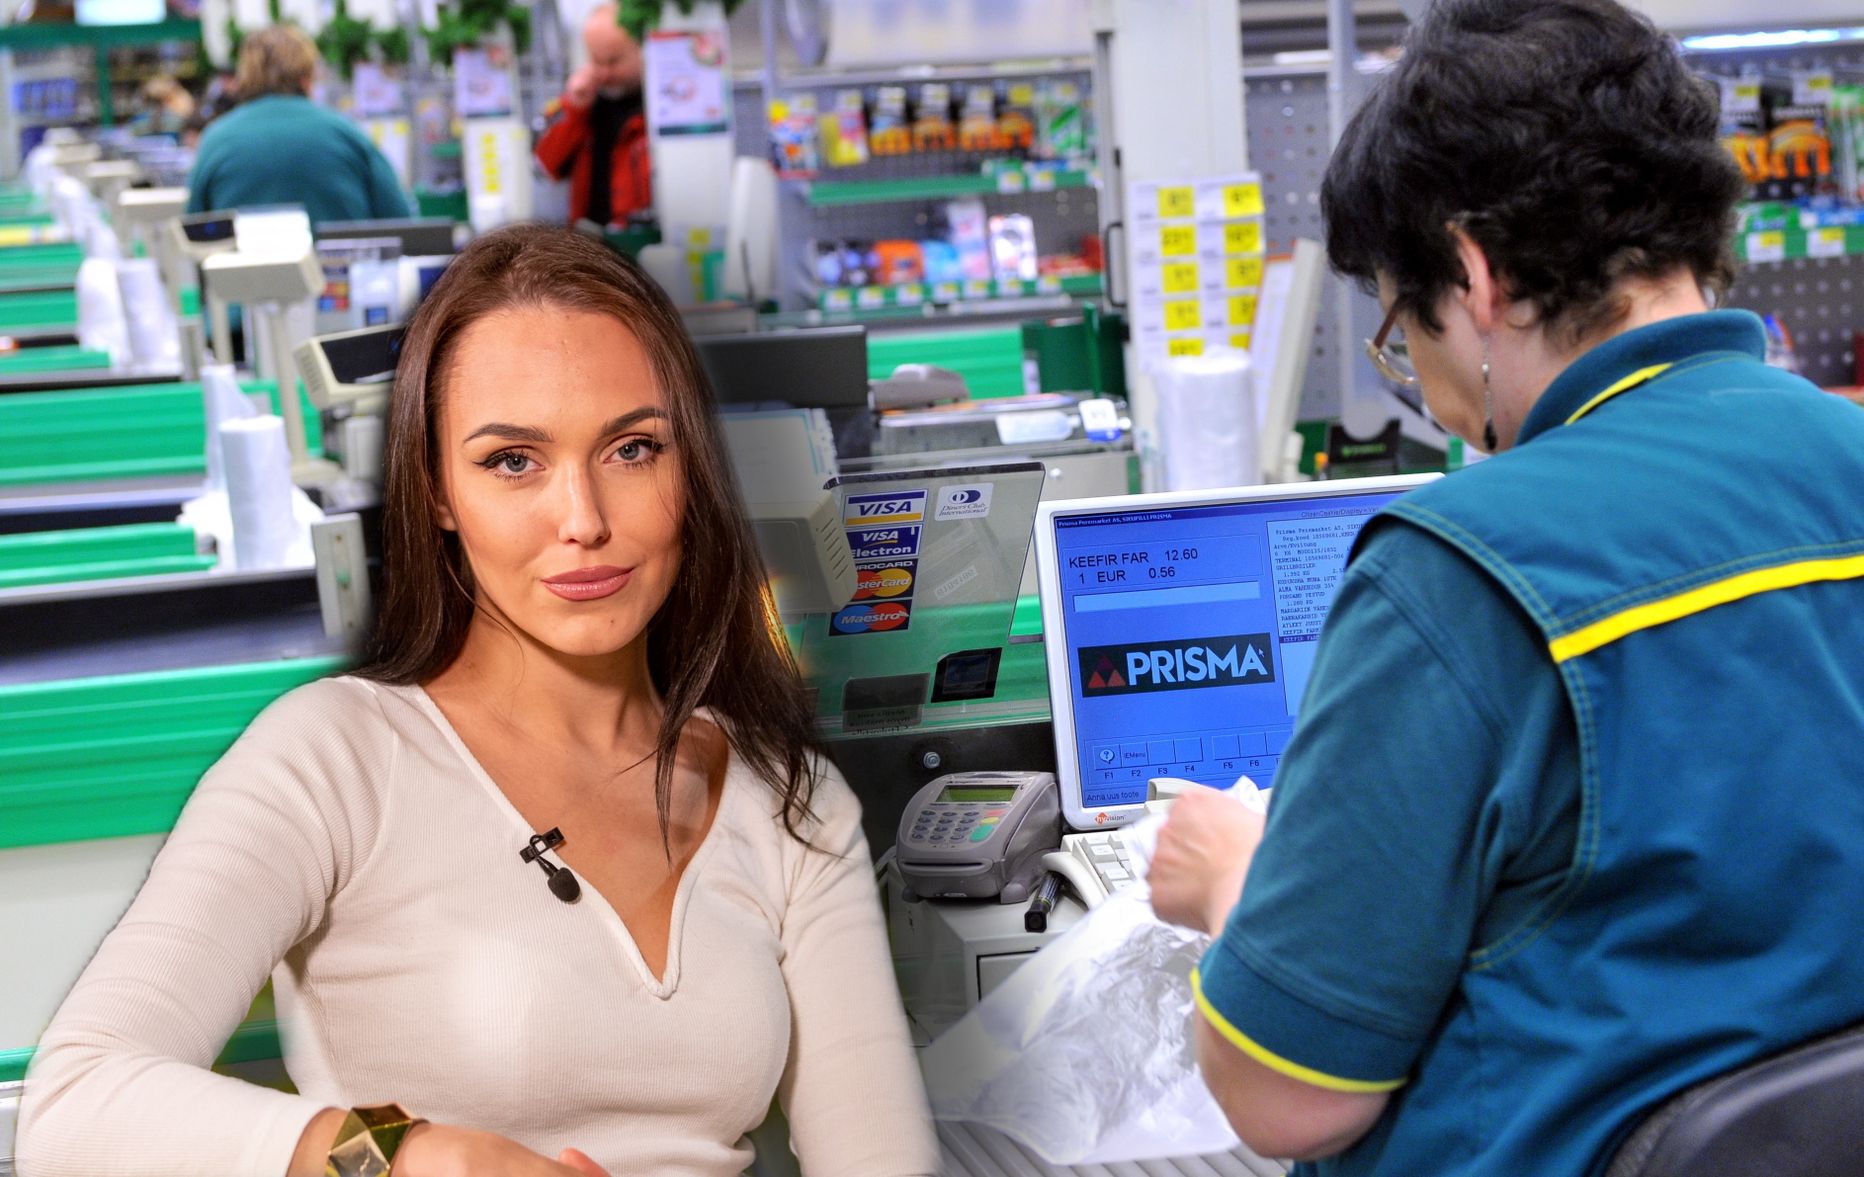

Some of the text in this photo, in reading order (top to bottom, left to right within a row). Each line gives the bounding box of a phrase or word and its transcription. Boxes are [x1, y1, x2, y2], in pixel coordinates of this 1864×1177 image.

[859, 501, 912, 516] VISA
[939, 507, 988, 516] International
[862, 531, 899, 542] VISA
[1069, 548, 1198, 568] KEEFIR FAR 12.60
[857, 561, 913, 570] ROCARD
[1080, 566, 1175, 584] 1 EUR 0.56
[857, 577, 910, 590] sterCard
[841, 611, 901, 625] Maestro
[1126, 643, 1268, 686] PRISMA
[1104, 771, 1114, 779] F1
[1131, 769, 1141, 777] F2
[1157, 767, 1168, 775] F3
[1250, 759, 1260, 767] F6
